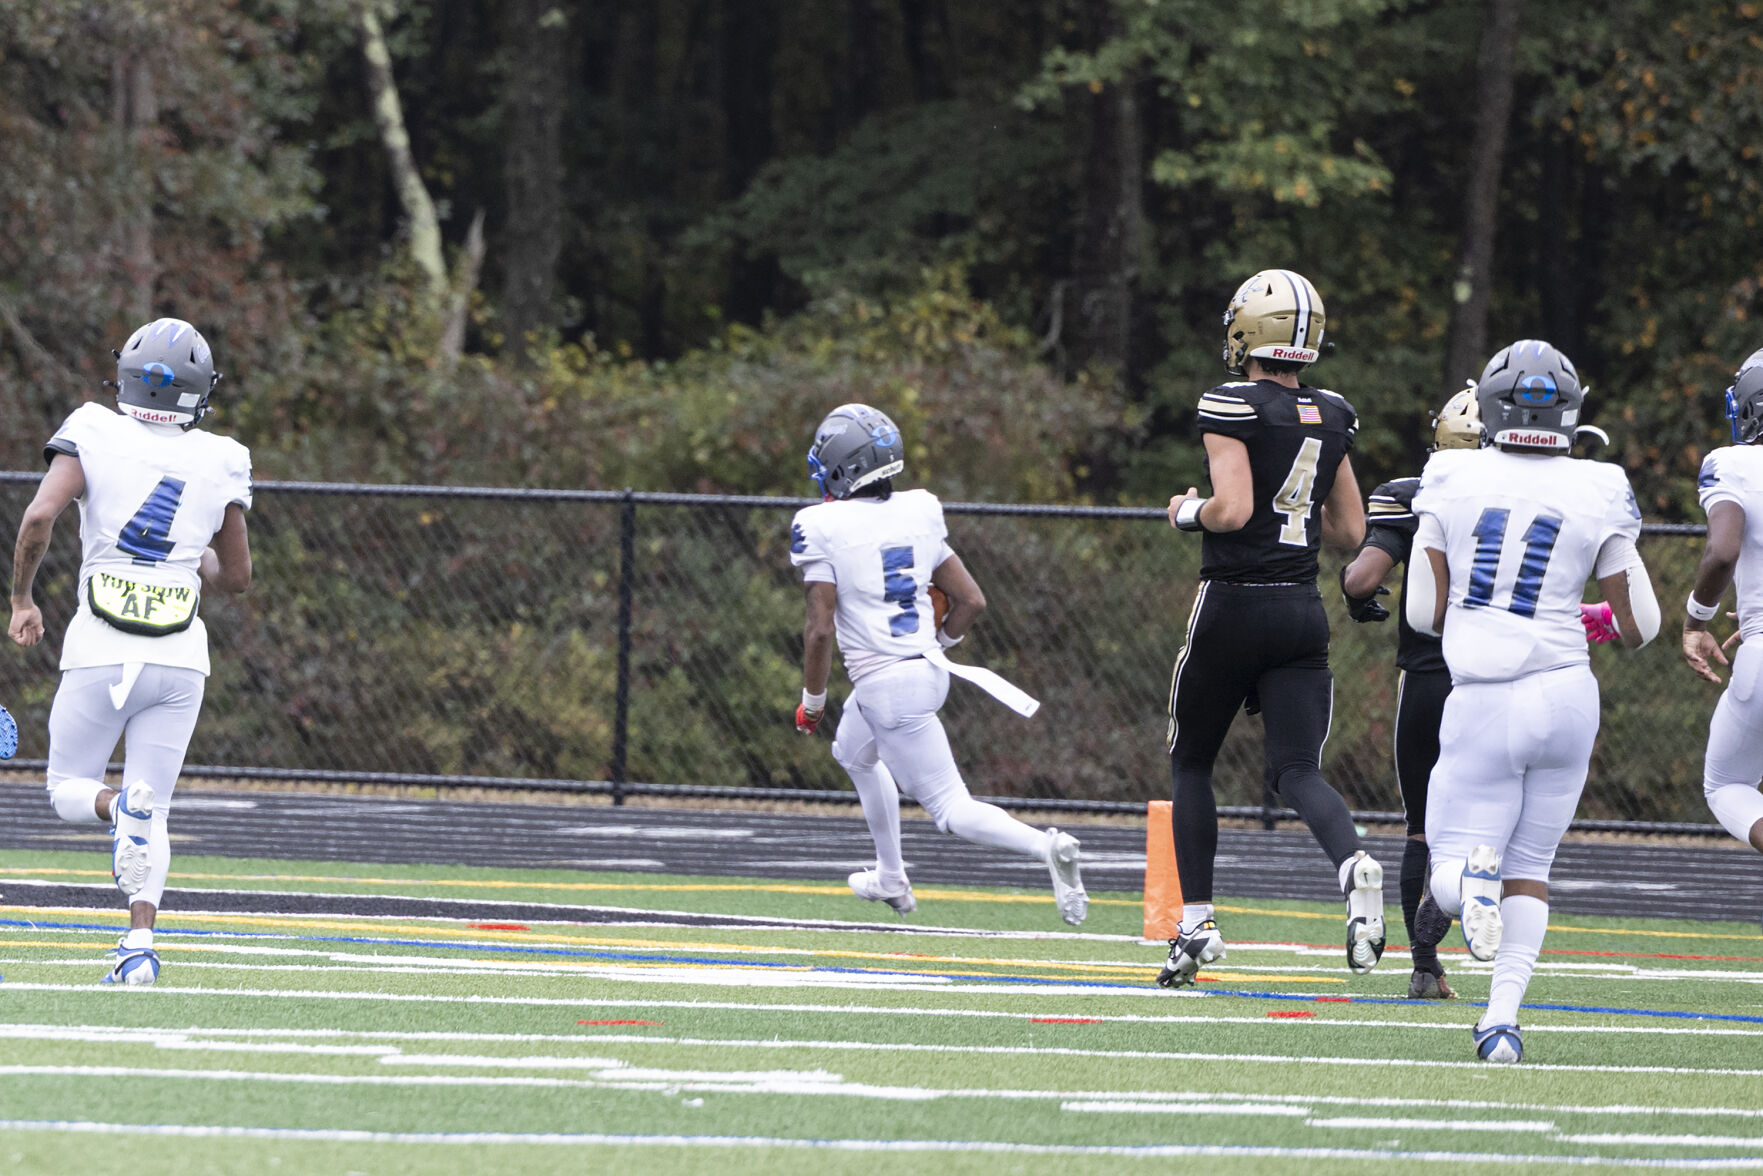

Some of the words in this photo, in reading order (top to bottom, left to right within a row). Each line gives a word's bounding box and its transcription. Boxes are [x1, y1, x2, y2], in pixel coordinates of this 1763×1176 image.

[1272, 348, 1315, 361] Riddell
[1508, 432, 1557, 446] Riddell
[115, 474, 187, 567] 4
[1272, 436, 1323, 547] 4
[121, 593, 158, 620] AF
[880, 545, 920, 638] 5
[1463, 507, 1564, 620] 11
